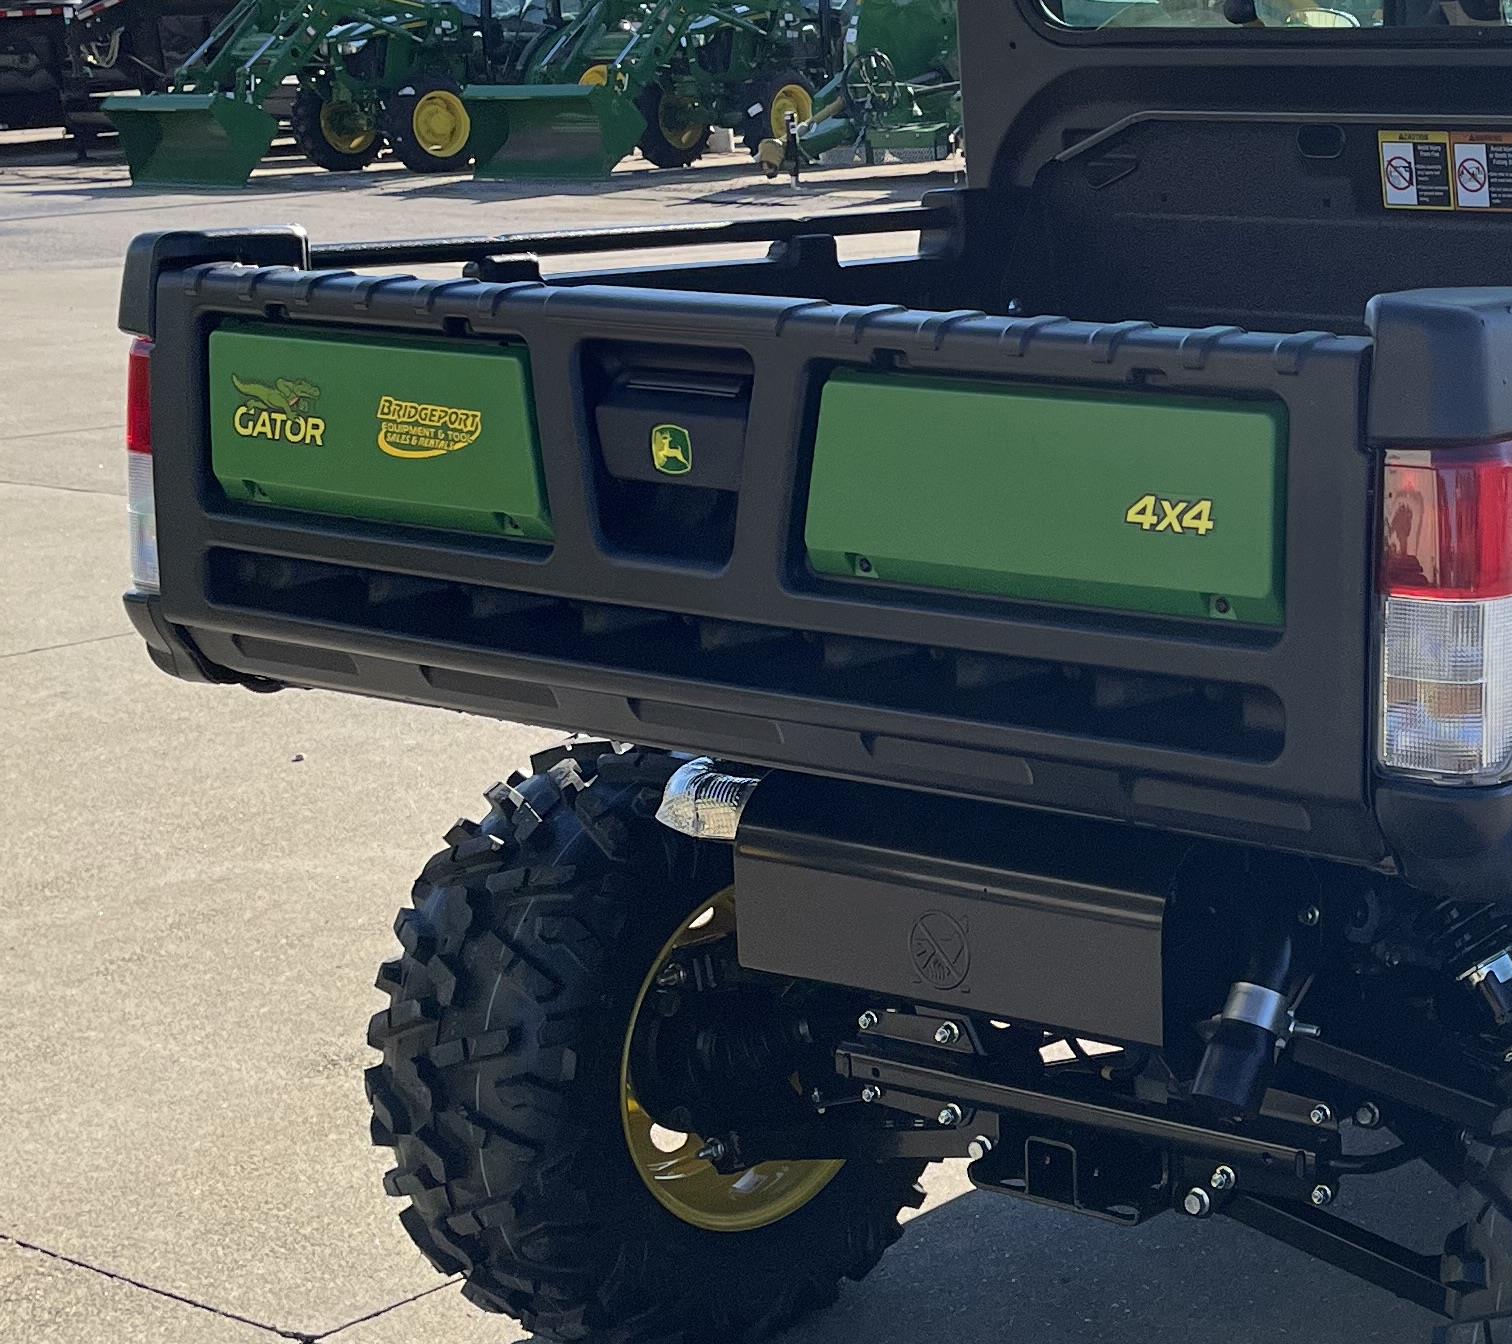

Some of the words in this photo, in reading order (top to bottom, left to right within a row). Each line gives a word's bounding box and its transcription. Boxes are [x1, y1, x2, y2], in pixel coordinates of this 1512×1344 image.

[233, 405, 326, 446] GATOR
[379, 397, 480, 431] BRIDGEPORT
[381, 422, 436, 437] EQUIPMENT
[386, 433, 411, 445] SALES
